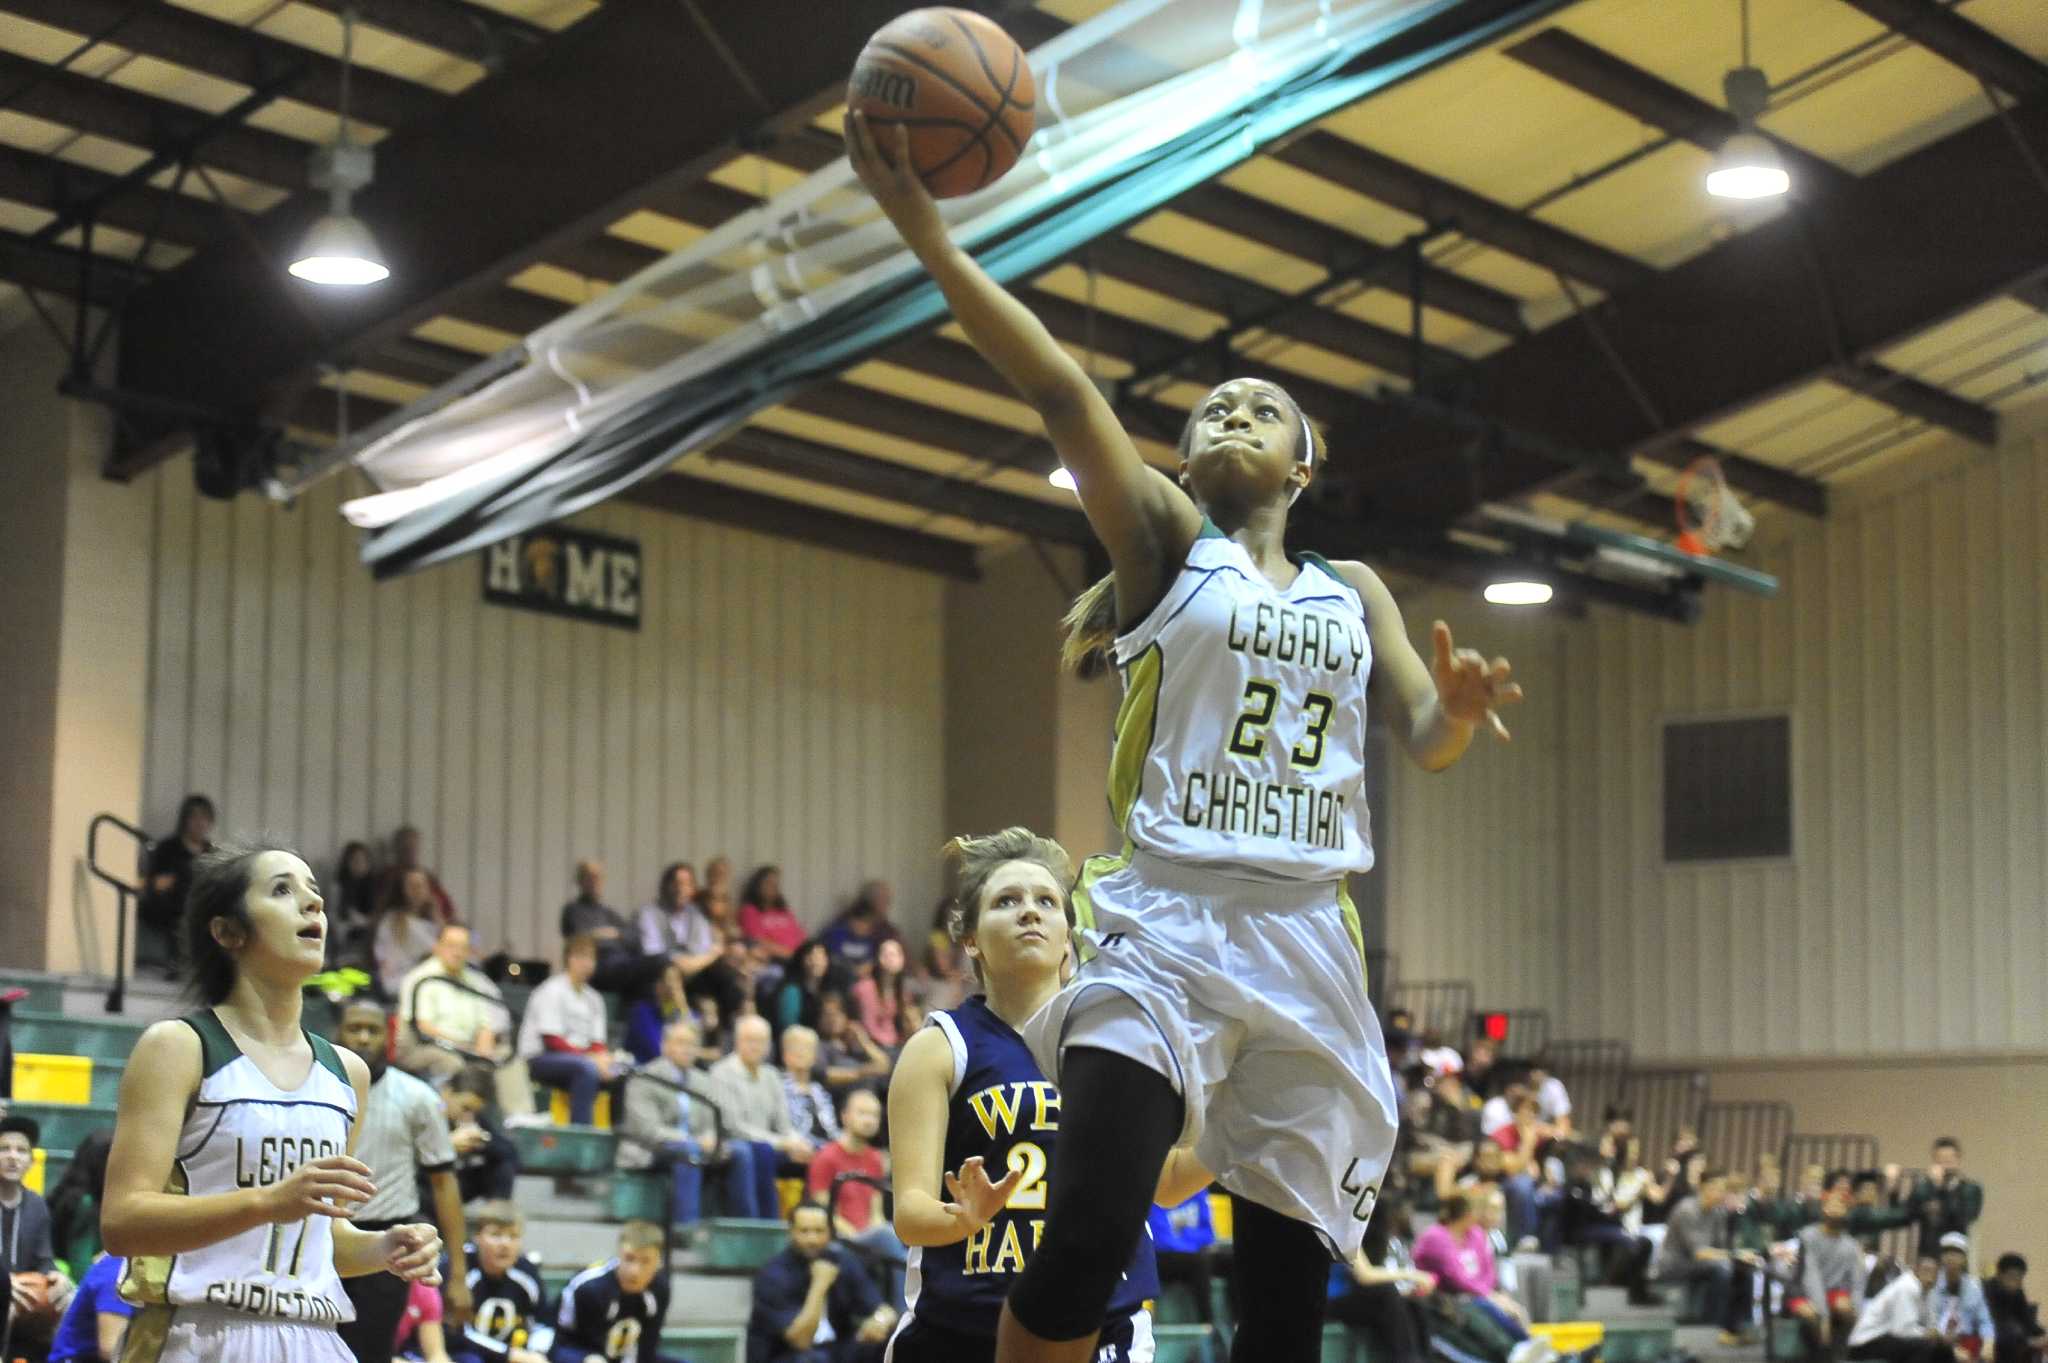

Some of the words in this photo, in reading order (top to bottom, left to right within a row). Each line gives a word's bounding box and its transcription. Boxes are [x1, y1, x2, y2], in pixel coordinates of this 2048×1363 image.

[489, 537, 637, 616] HME
[1228, 602, 1364, 677] LEGACY
[1226, 678, 1336, 771] 23
[1182, 772, 1345, 850] CHRISTIAN
[968, 1081, 1062, 1140] WE
[236, 1136, 341, 1188] LEG
[963, 1219, 1046, 1275] HA
